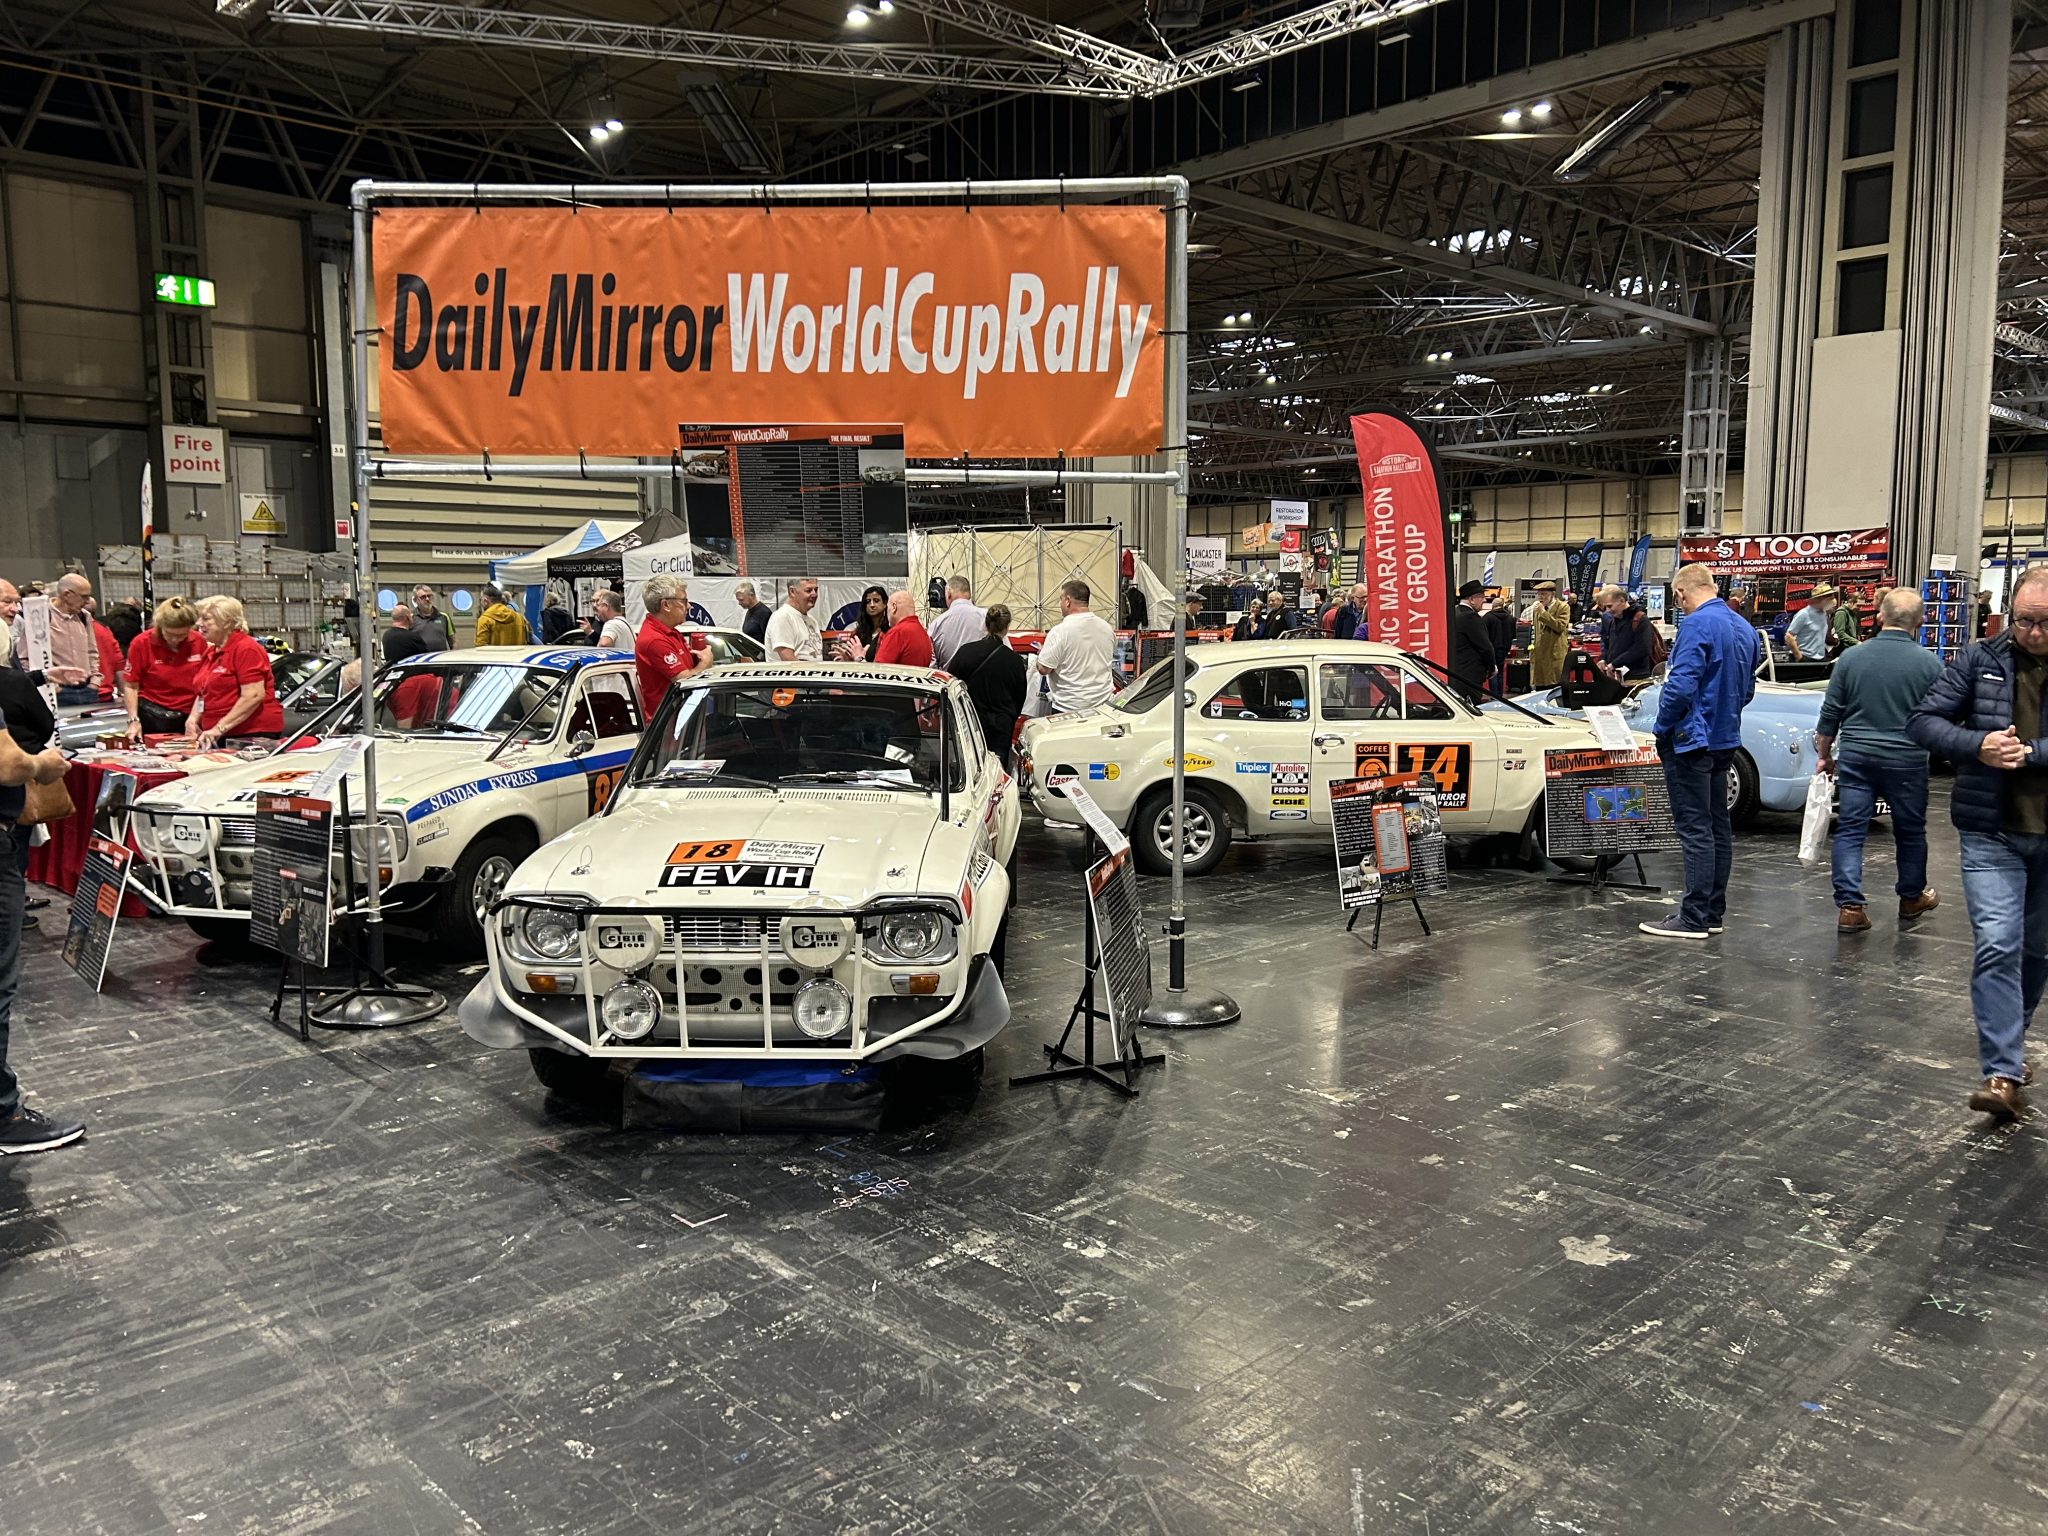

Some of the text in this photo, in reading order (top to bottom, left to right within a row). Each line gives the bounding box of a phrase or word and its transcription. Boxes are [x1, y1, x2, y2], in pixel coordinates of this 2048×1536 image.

[174, 434, 213, 452] Fire
[170, 456, 222, 474] point
[1275, 507, 1305, 515] RESTORATION
[1374, 487, 1401, 610] MARATHON
[1716, 533, 1853, 559] ST TOOLS
[1191, 548, 1223, 560] LANCASTER
[1743, 558, 1782, 566] WORKSHOP
[1813, 554, 1868, 563] CONSUMABLES
[650, 555, 693, 574] Car Club
[1191, 560, 1215, 568] INSURANCE
[1405, 524, 1430, 603] GROUP
[1743, 565, 1768, 573] TODAY
[719, 670, 835, 678] TELEGRAPH
[1358, 745, 1388, 753] COFFEE
[1549, 746, 1661, 771] DailyMirror WorldCupR
[1237, 762, 1268, 772] Triplex
[1275, 763, 1306, 773] Autolite
[1408, 746, 1460, 792] 14
[429, 769, 538, 811] SUNDAY EXPRESS
[1273, 786, 1307, 794] FERODO
[1437, 792, 1467, 801] IRROR
[682, 843, 733, 859] 18
[750, 841, 818, 851] Daily Mirror
[667, 865, 752, 886] FEV
